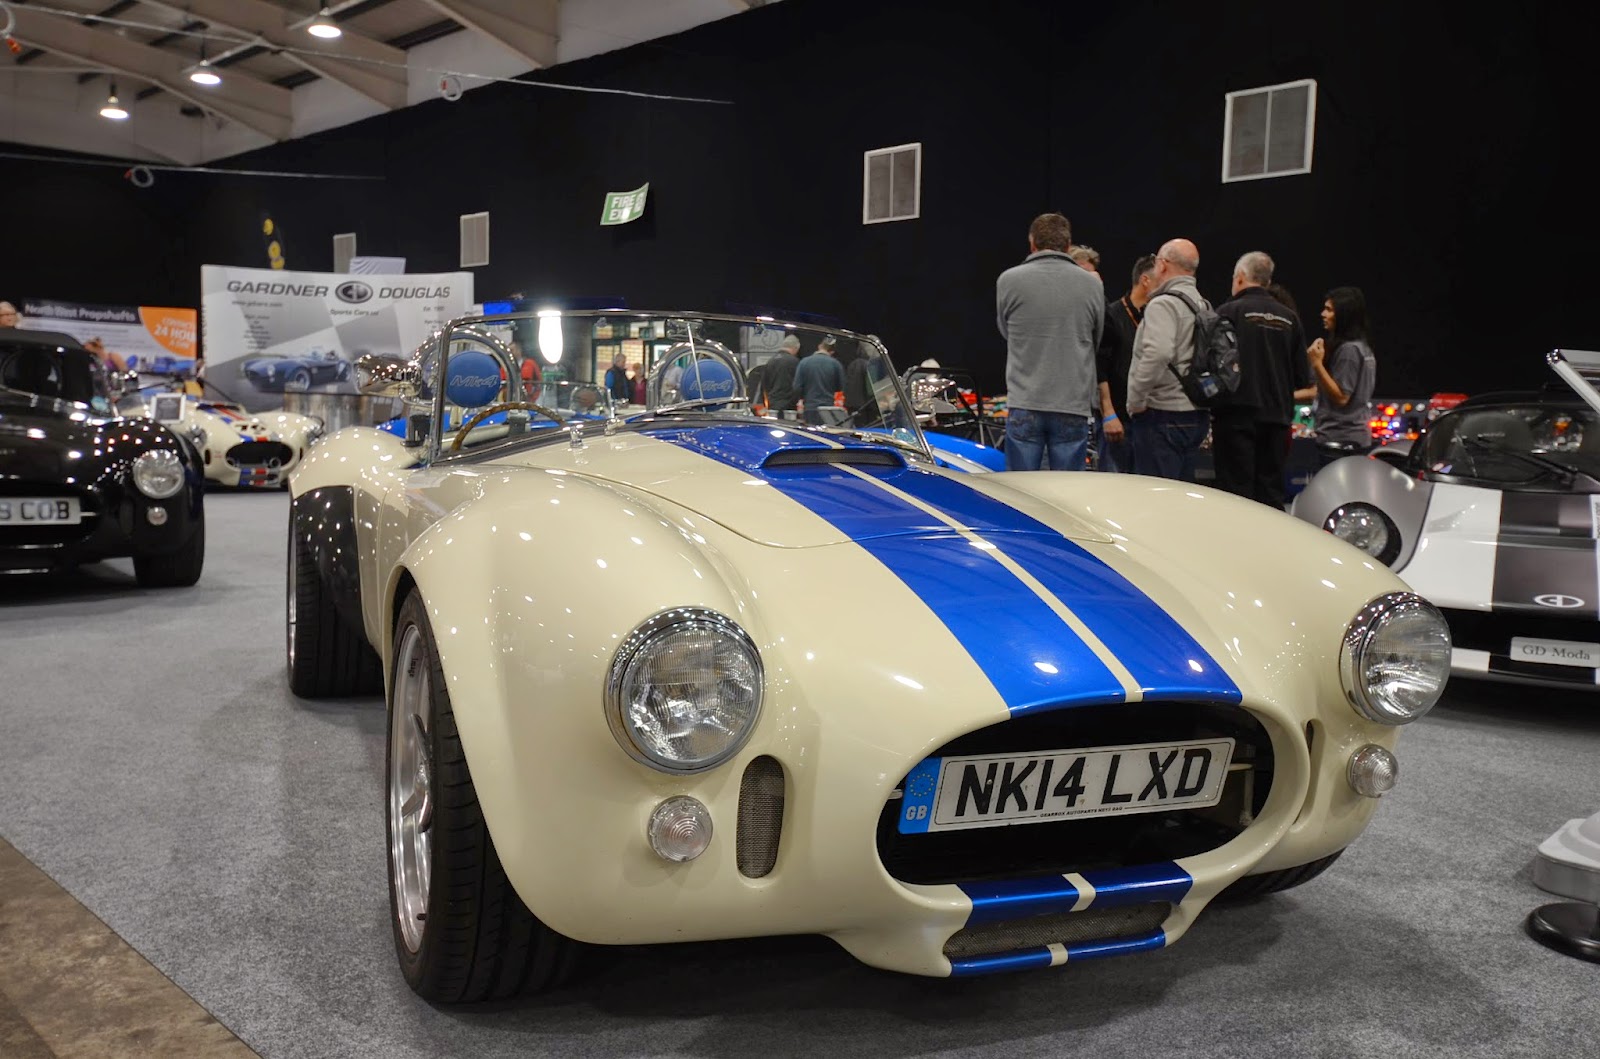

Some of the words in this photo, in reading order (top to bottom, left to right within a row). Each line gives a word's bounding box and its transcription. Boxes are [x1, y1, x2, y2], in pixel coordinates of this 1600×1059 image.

[611, 194, 636, 208] FIRE
[609, 207, 632, 221] EX
[226, 280, 329, 298] GARDNER
[378, 286, 451, 300] DOUGLAS
[79, 307, 136, 321] Propshafts
[153, 323, 169, 336] 24
[450, 374, 499, 388] Mk4
[689, 379, 732, 392] Mk4
[21, 501, 70, 520] COB
[1522, 644, 1546, 656] GD
[1551, 647, 1591, 661] Moda
[955, 757, 1086, 817] NK14
[1101, 748, 1212, 805] LXD
[905, 805, 928, 821] GB
[1066, 808, 1097, 816] AUTOPARTS
